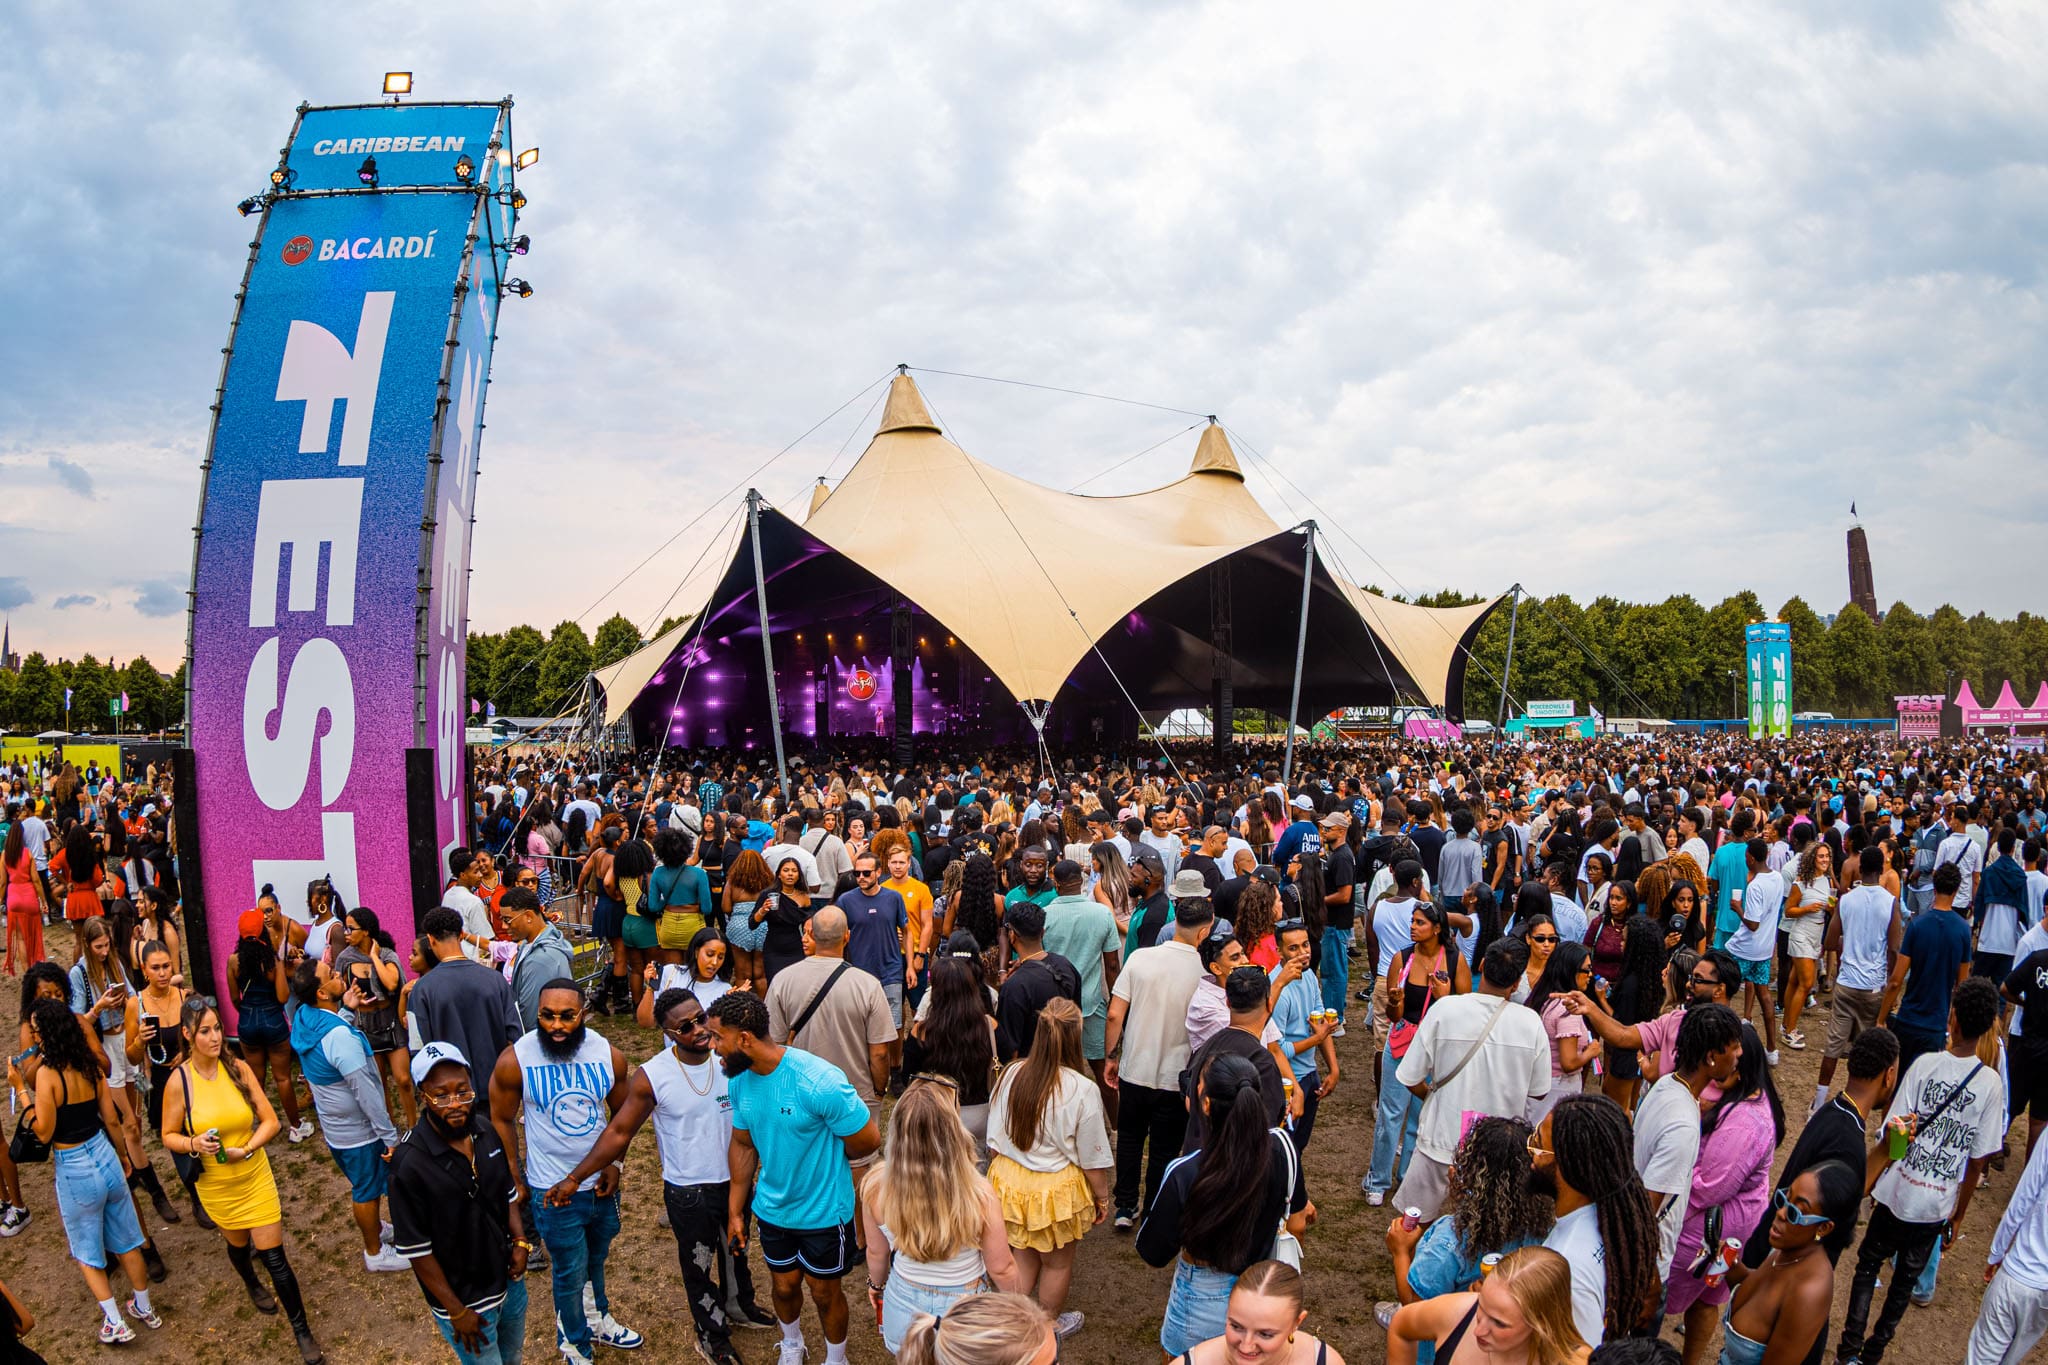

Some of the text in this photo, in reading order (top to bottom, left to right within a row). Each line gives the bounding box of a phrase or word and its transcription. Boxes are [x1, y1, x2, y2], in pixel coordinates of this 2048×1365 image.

[313, 136, 465, 156] CARIBBEAN
[317, 229, 438, 261] BACARDÍ
[526, 1062, 611, 1114] NIRVANA
[1922, 1079, 1976, 1113] KEP
